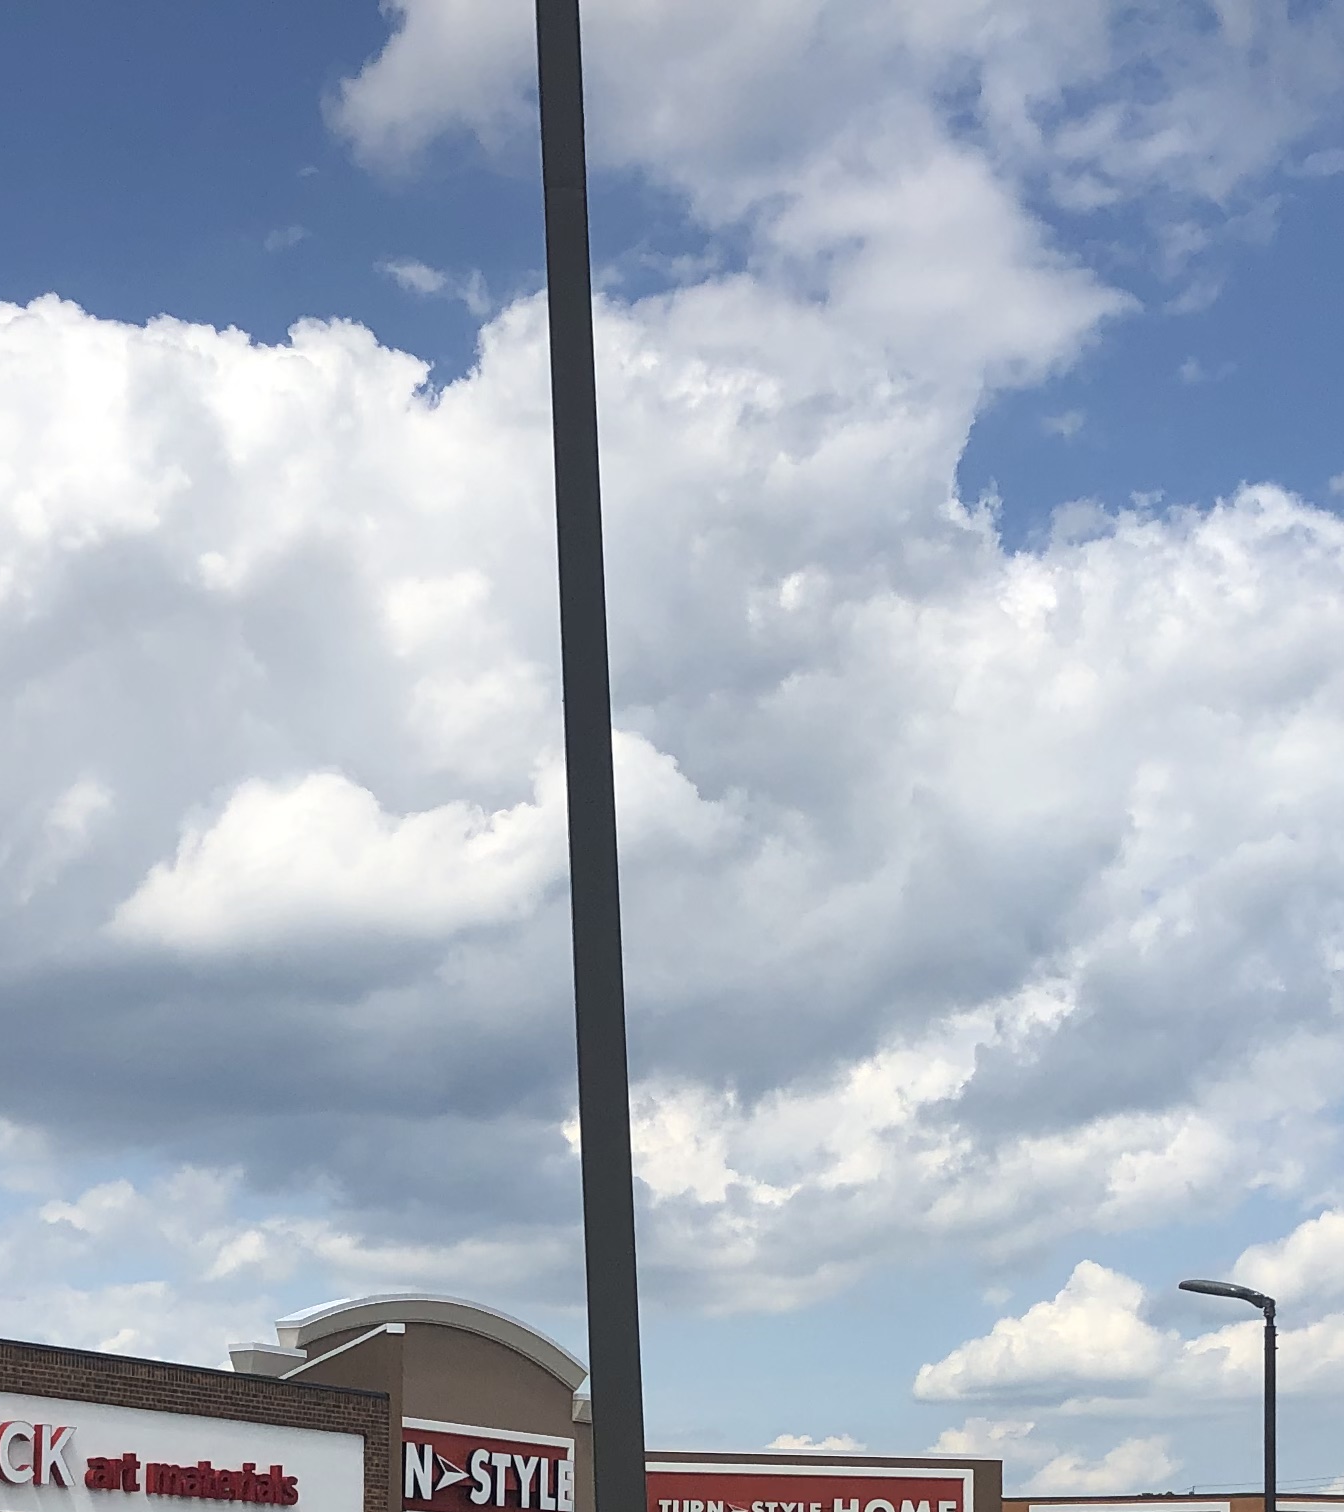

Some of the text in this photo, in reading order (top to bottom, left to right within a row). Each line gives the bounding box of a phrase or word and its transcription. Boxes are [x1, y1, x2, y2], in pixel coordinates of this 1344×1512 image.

[85, 1453, 141, 1492] art
[146, 1461, 299, 1506] materials
[470, 1448, 574, 1512] STYLE
